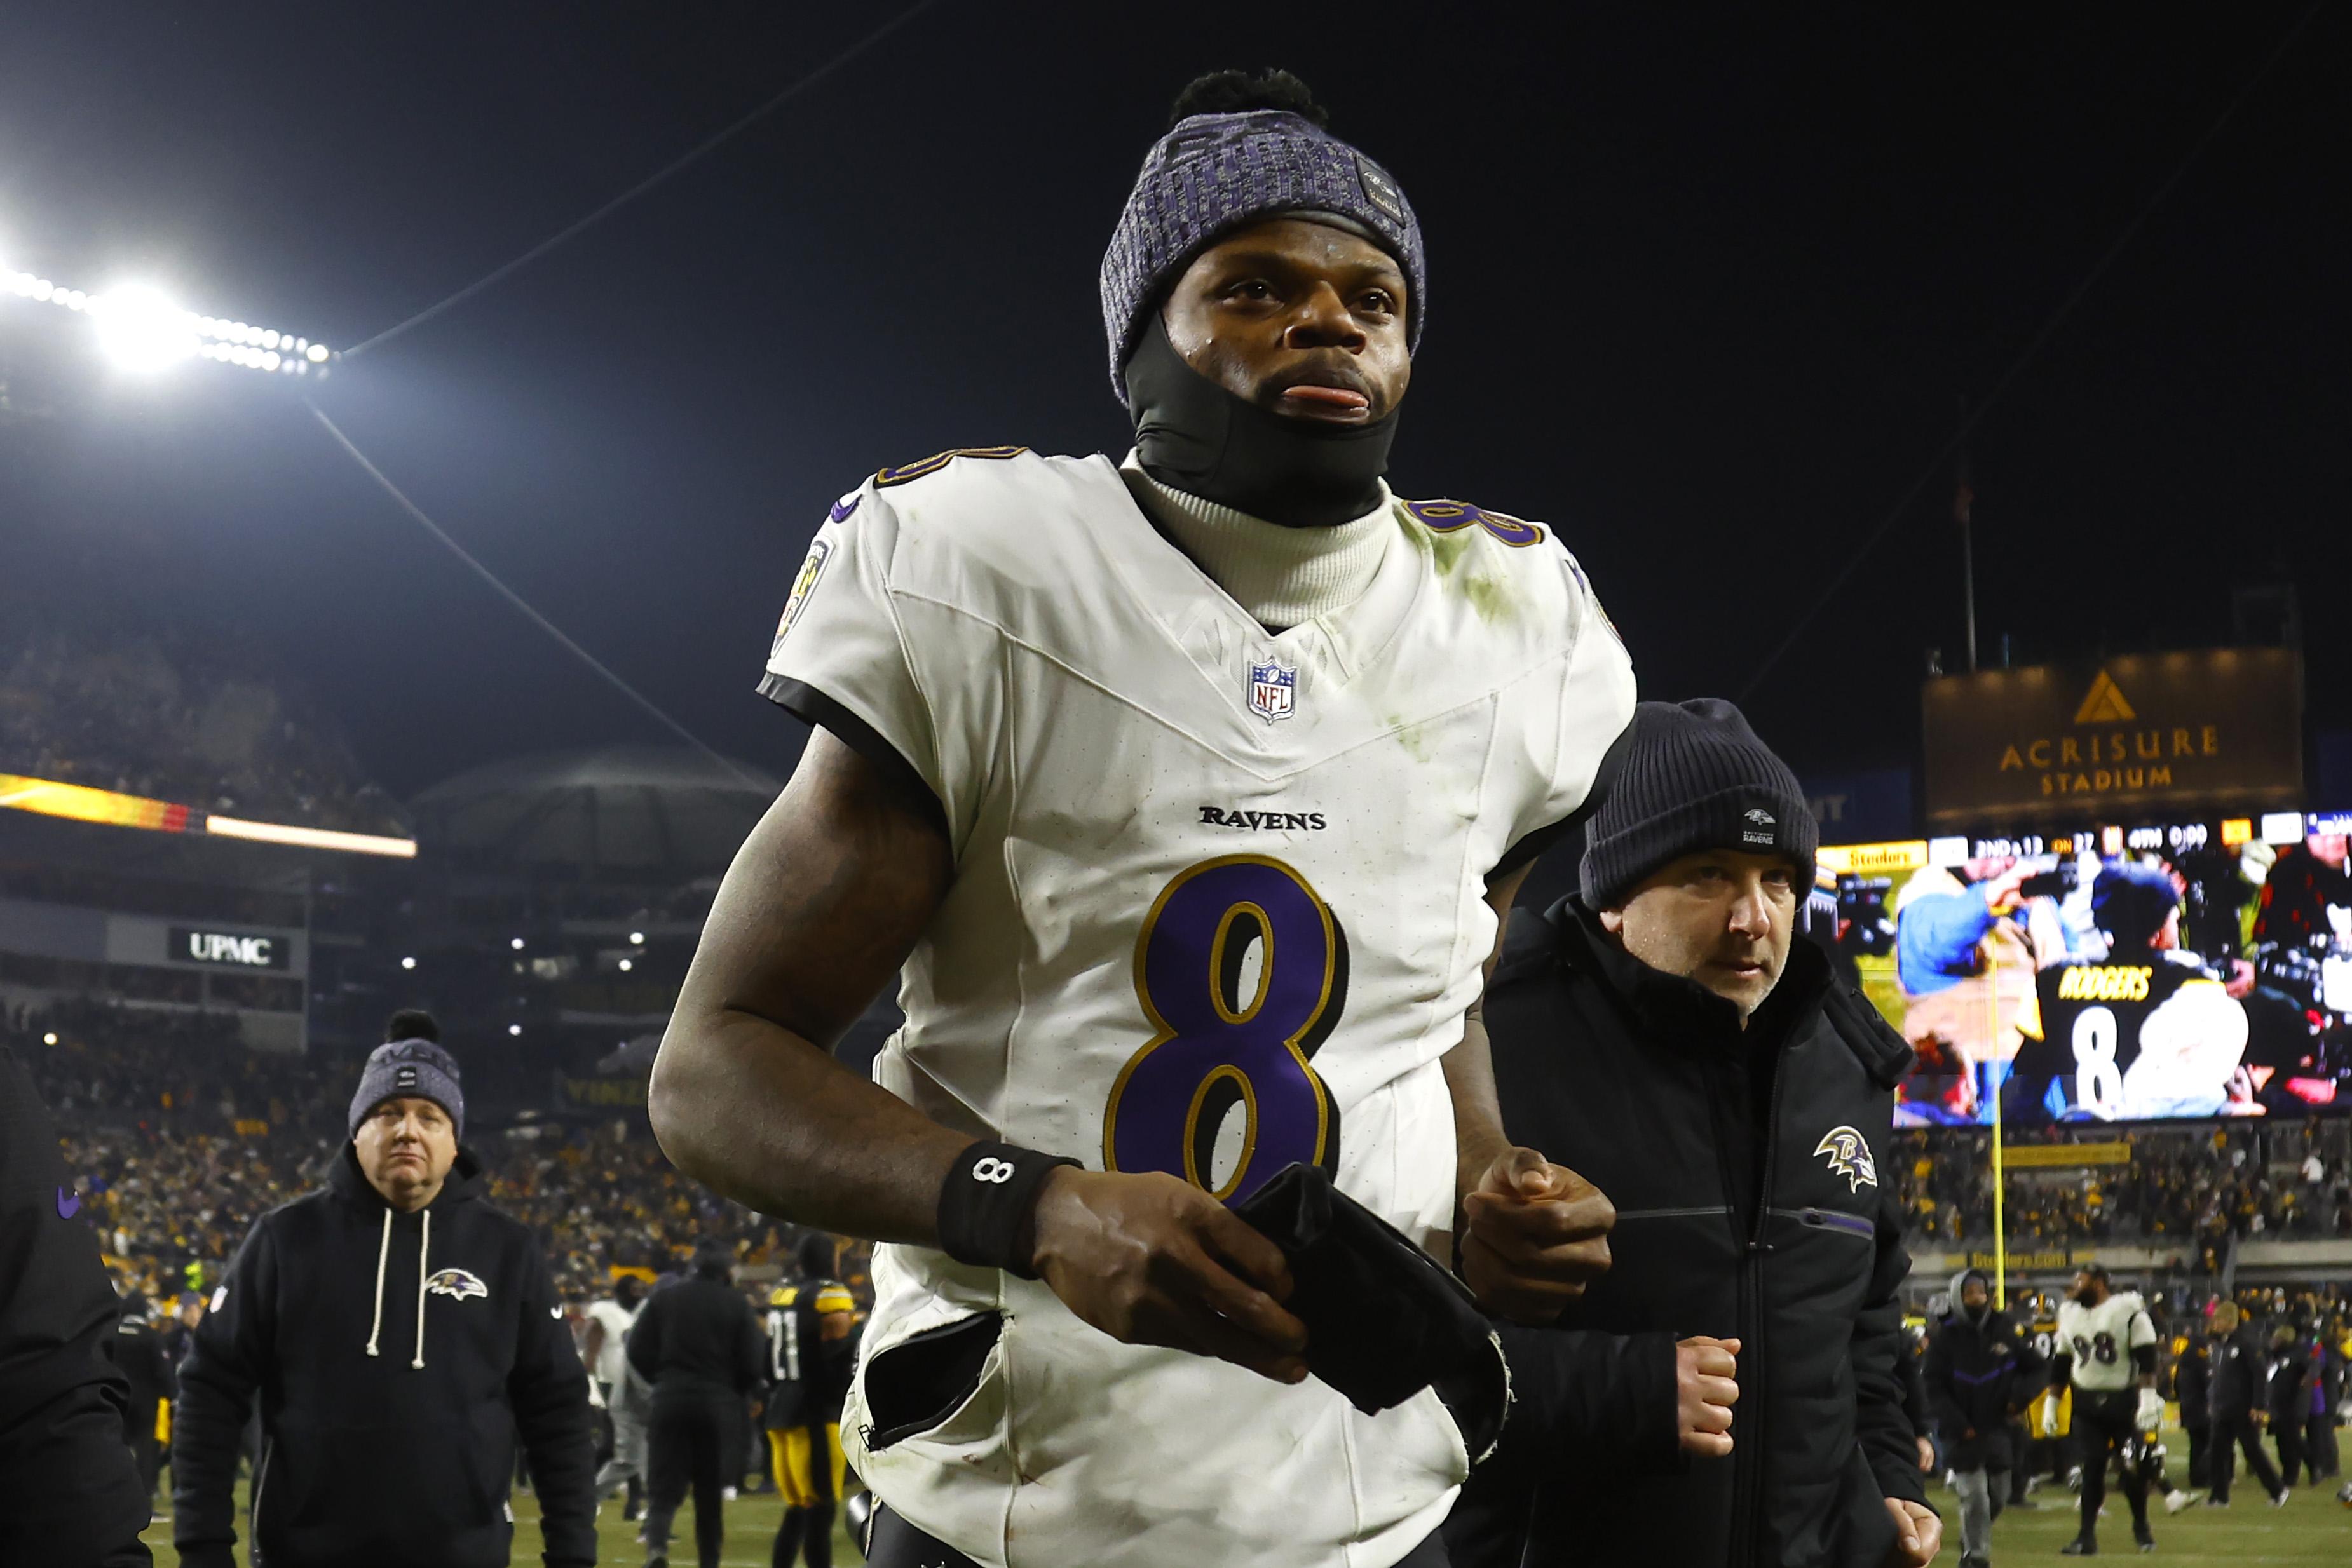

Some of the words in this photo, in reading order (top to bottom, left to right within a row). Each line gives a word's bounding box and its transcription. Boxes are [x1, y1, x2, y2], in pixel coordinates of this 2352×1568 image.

[1256, 684, 1288, 711] NFL
[1999, 725, 2217, 771] ACRISURE
[2042, 764, 2171, 795] STADIUM
[1199, 806, 1327, 831] RAVENS
[2128, 827, 2162, 849] 4TH
[2169, 825, 2207, 848] 0:00
[1849, 849, 1912, 867] Steelers
[190, 932, 271, 966] UPMC
[2058, 965, 2153, 1002] RODGERS
[1102, 853, 1350, 1203] 8
[2071, 1005, 2123, 1115] 8
[973, 1157, 1015, 1184] 8
